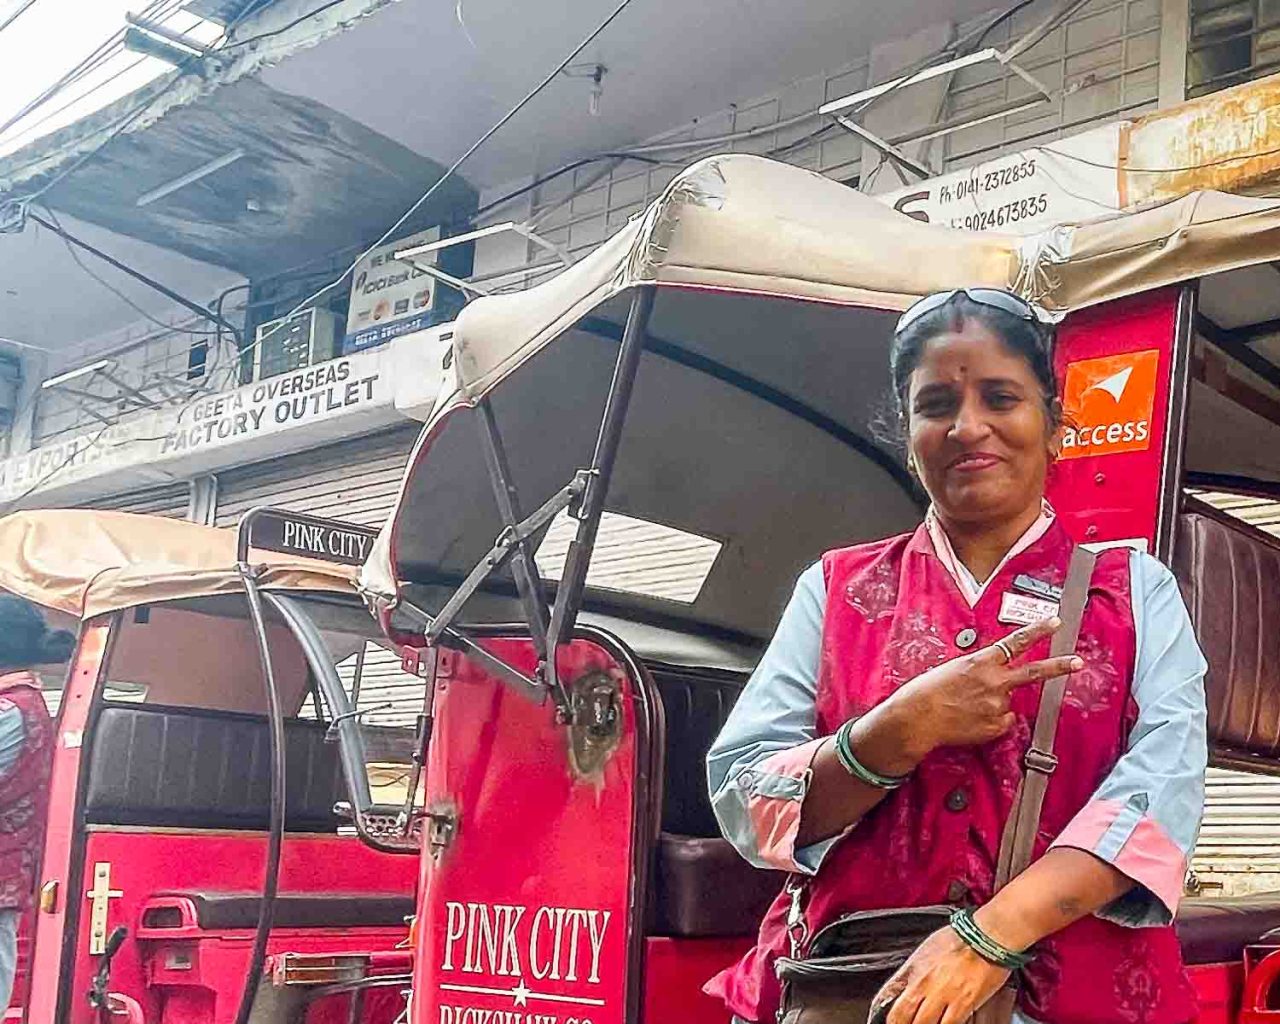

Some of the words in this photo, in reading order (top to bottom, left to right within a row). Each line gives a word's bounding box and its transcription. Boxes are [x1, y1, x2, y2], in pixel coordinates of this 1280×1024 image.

[252, 361, 351, 403] OVERSEAS
[161, 405, 265, 453] FACTORY
[274, 374, 379, 424] OUTLET
[1062, 419, 1149, 449] access
[283, 521, 325, 553] PINK
[328, 530, 368, 560] CITY
[441, 901, 526, 977] PINK
[529, 906, 612, 984] CITY
